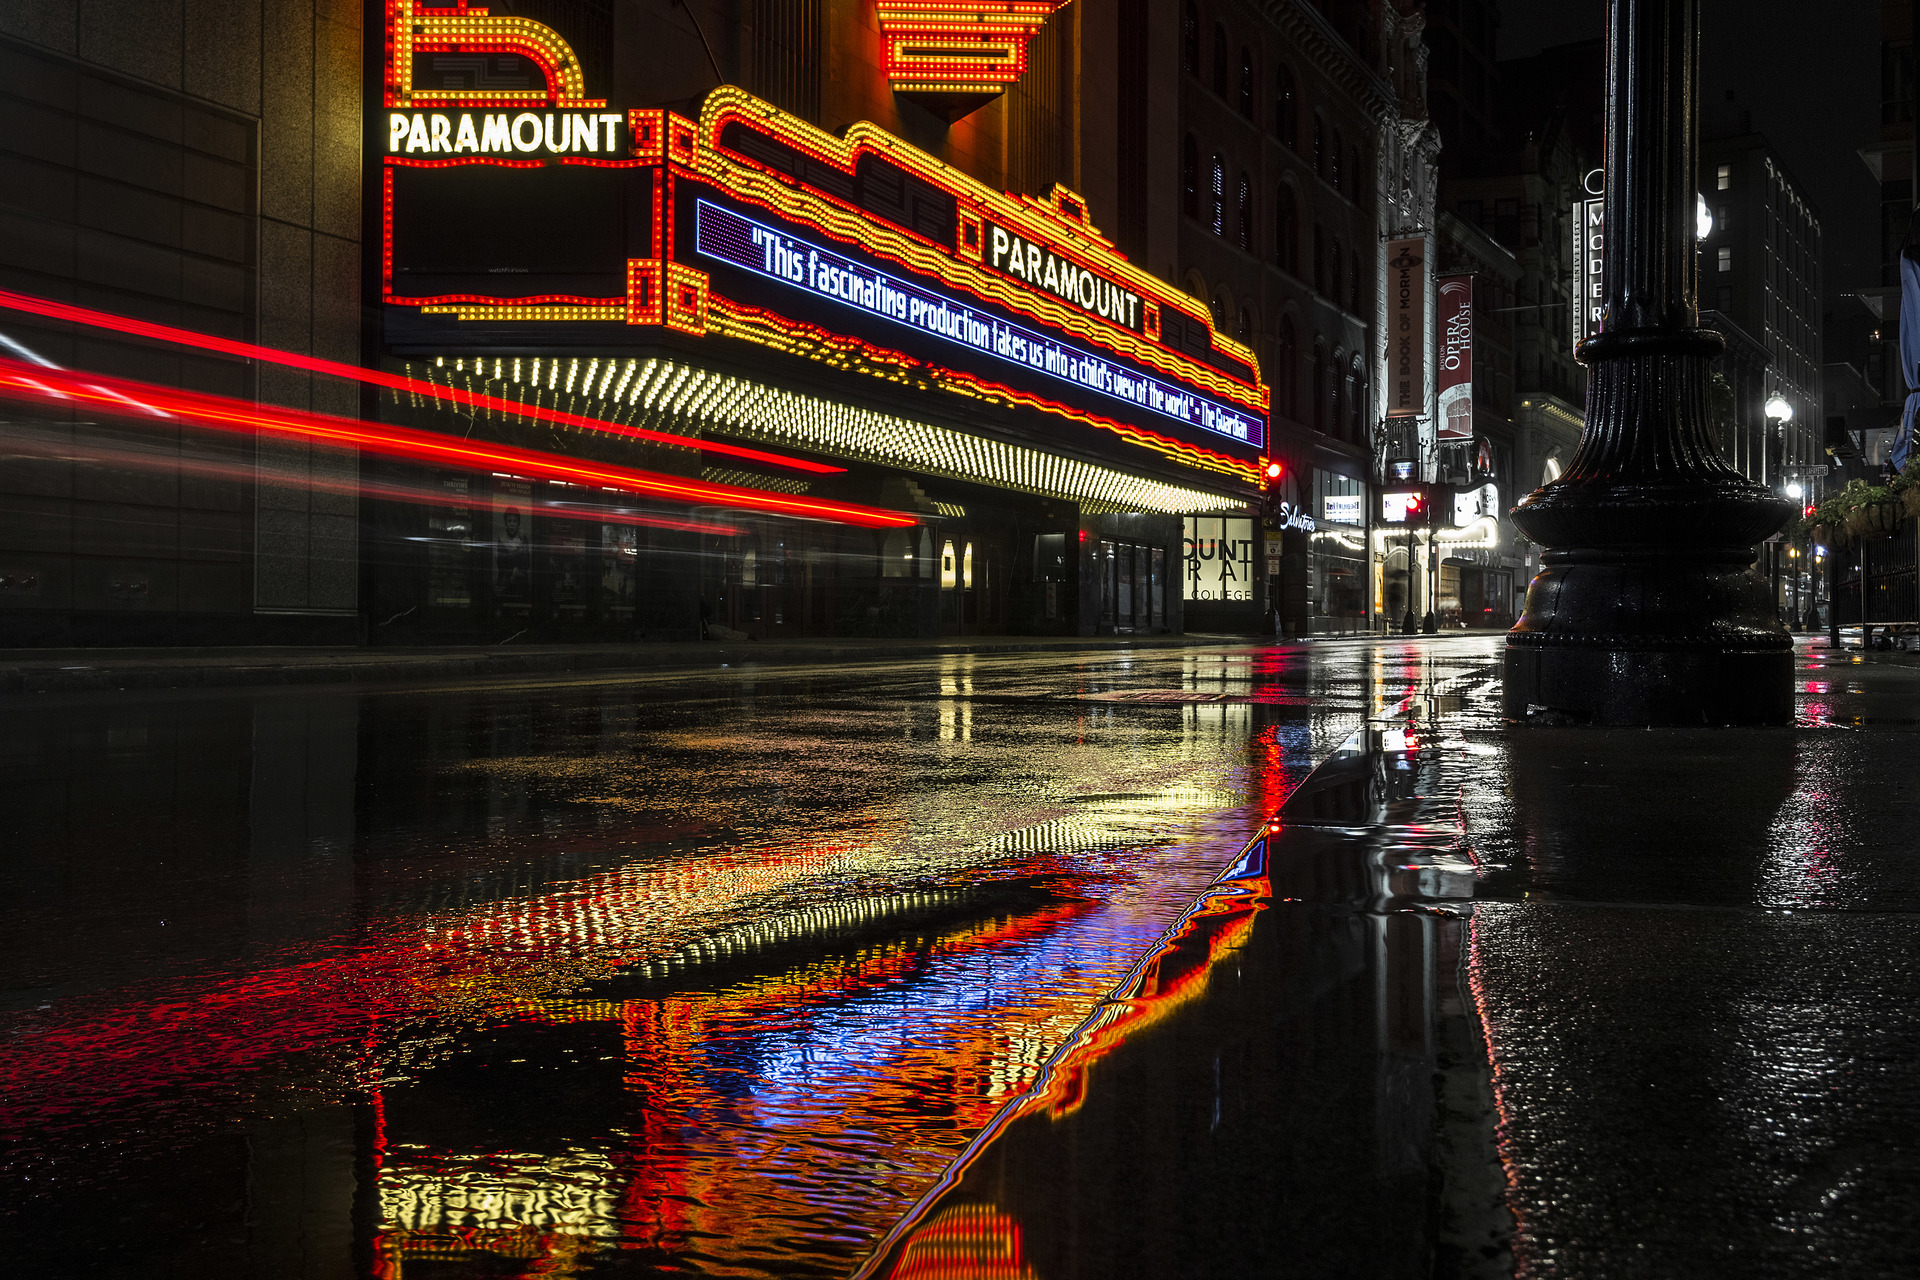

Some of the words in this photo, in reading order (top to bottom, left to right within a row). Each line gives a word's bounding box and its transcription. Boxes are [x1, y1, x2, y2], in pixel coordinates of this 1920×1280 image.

[389, 113, 622, 153] PARAMOUNT
[992, 226, 1138, 328] PARAMOUNT
[1400, 247, 1411, 309] MORMON
[1589, 212, 1604, 338] MODER
[752, 226, 803, 283] "This
[809, 250, 906, 320] fascinating
[909, 296, 989, 350] production
[992, 320, 1027, 362] takes
[1029, 341, 1044, 368] us
[1045, 341, 1068, 377] into
[1069, 357, 1077, 380] a
[1079, 356, 1112, 392] child's
[1113, 370, 1135, 400] view
[1136, 379, 1147, 404] of
[1149, 381, 1164, 410] the
[1201, 400, 1215, 429] The
[1216, 407, 1248, 440] Guardian
[1400, 313, 1411, 332] OF
[1445, 314, 1460, 371] OPERA
[1460, 302, 1471, 350] HOUSE
[1400, 336, 1411, 374] BOOK
[1400, 381, 1411, 407] THE
[1218, 560, 1253, 581] AT
[1191, 589, 1252, 601] COLLEGE
